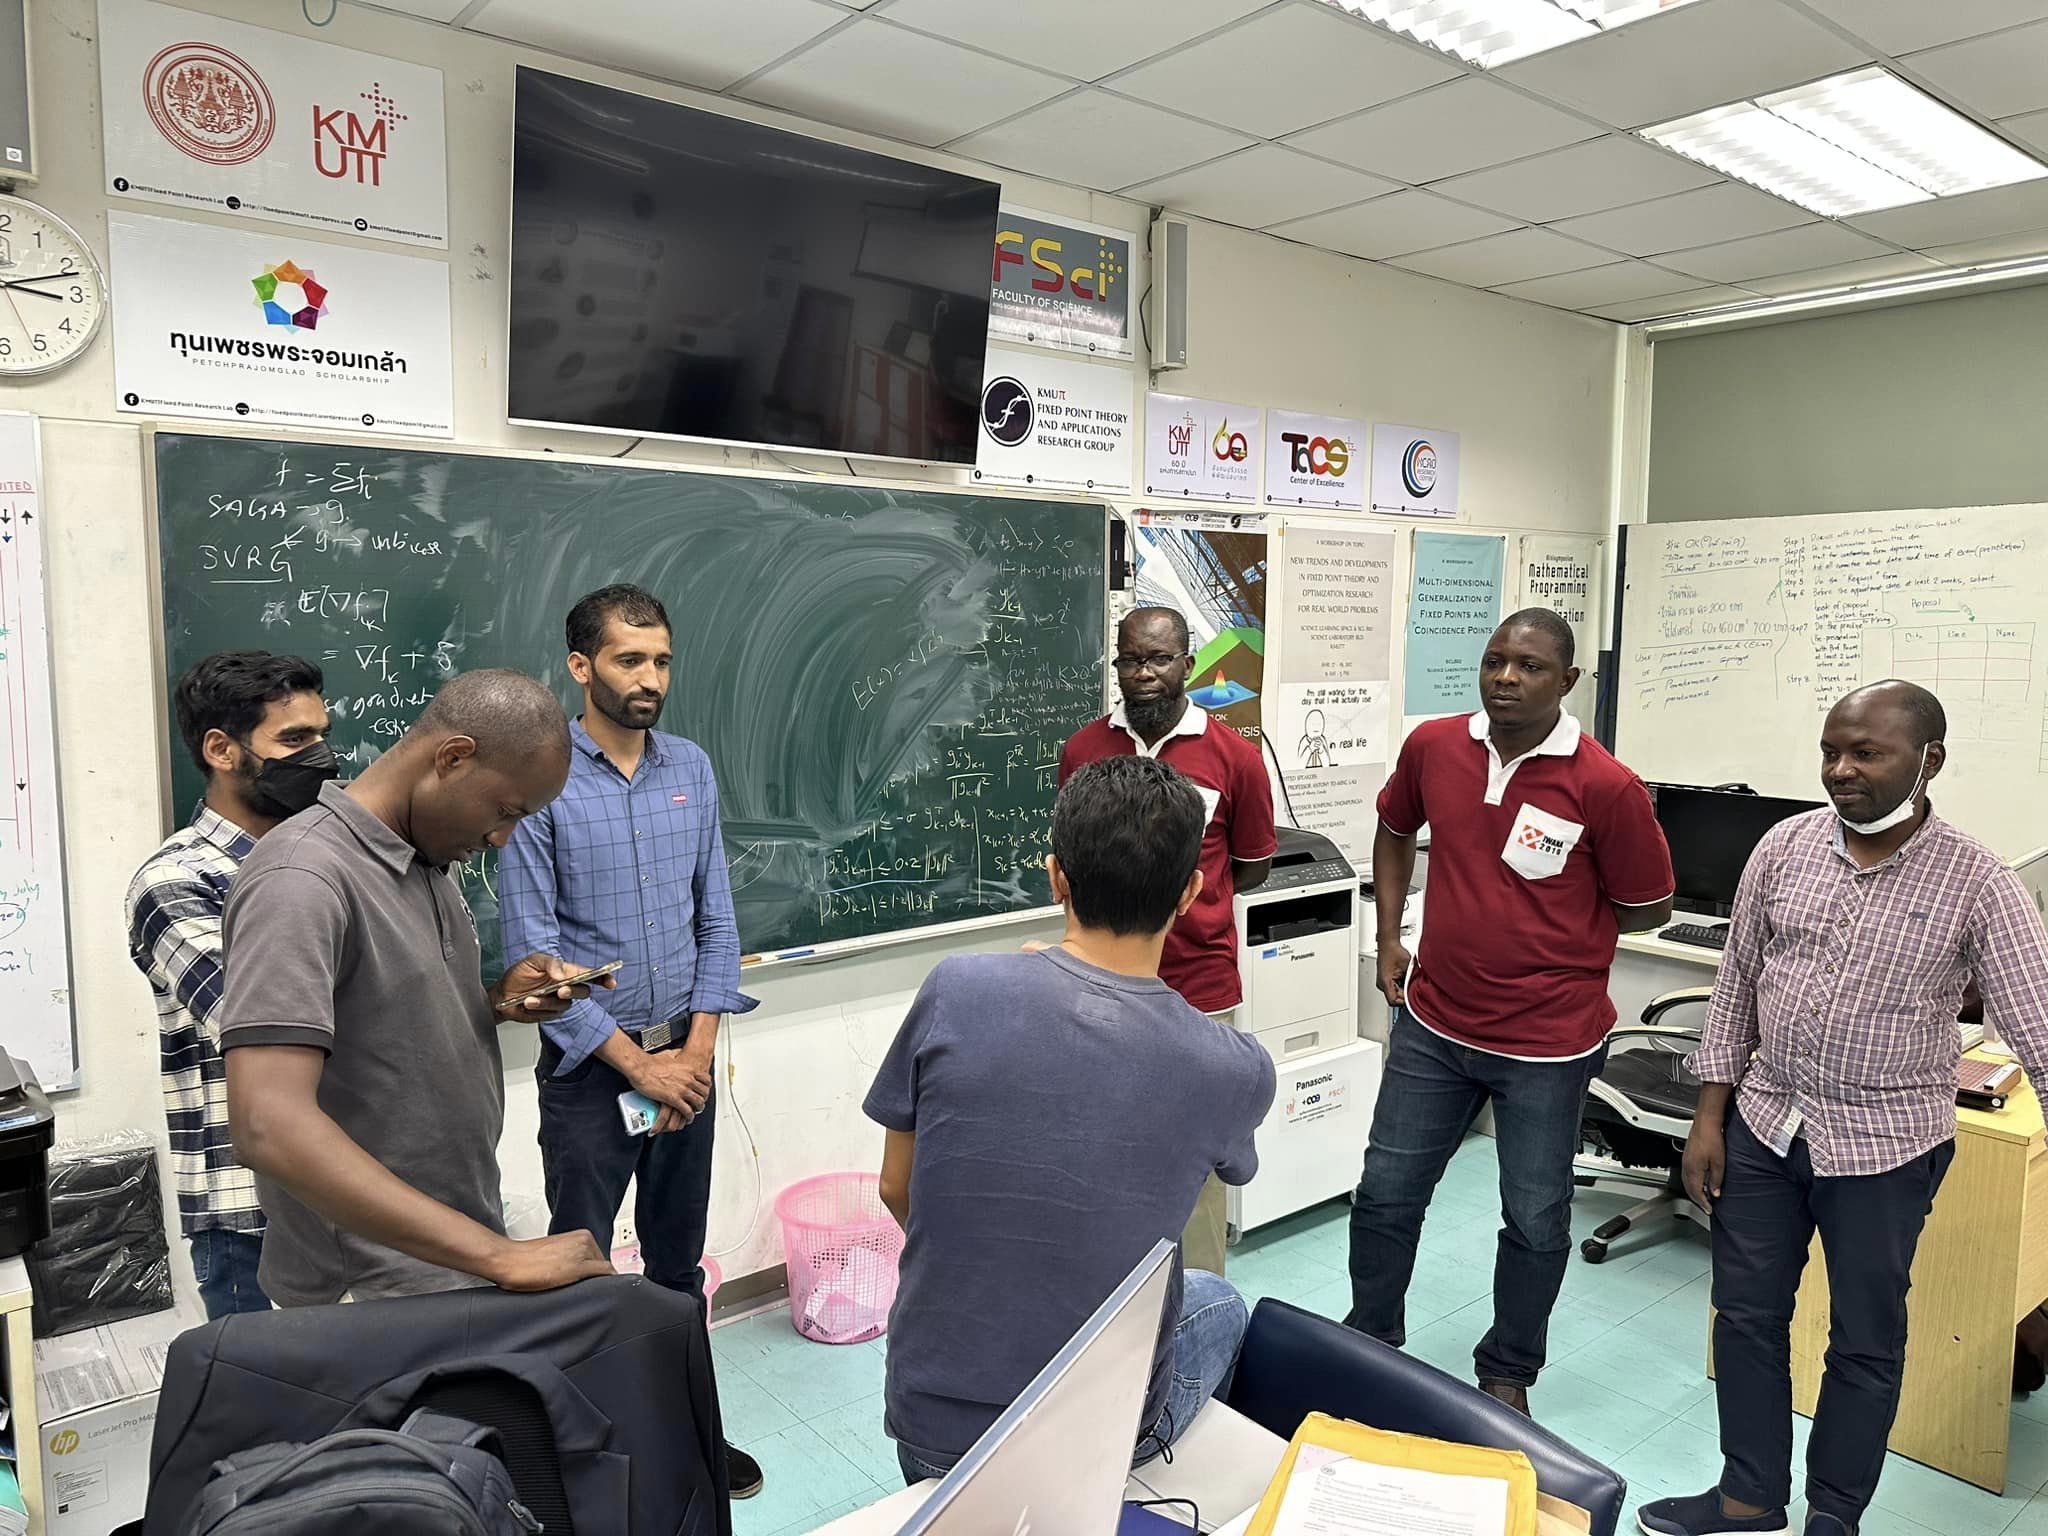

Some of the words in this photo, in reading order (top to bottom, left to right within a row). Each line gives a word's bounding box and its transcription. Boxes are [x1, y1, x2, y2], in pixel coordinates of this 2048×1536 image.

[33, 231, 41, 248] 1
[60, 257, 74, 275] 2
[70, 286, 84, 303] 3
[992, 288, 1036, 304] FACULTY
[1037, 298, 1051, 309] OF
[1053, 300, 1092, 317] SCIENCE
[59, 318, 72, 334] 4
[33, 334, 47, 351] 5
[170, 331, 407, 374] ทุนเพชรพระจอมเกล้า
[315, 371, 391, 384] SCHOLARSHIP
[1037, 403, 1063, 415] FIXED
[1065, 407, 1092, 419] POINT
[1095, 410, 1128, 424] THEORY
[1038, 419, 1058, 430] AND
[1061, 422, 1121, 438] APPLICATIONS
[1038, 435, 1081, 449] RESEARCH
[1084, 440, 1115, 452] GROUP
[1290, 476, 1308, 485] Center
[1316, 479, 1345, 488] Excellence
[208, 494, 287, 520] SAGA
[200, 545, 293, 582] SVRG
[1290, 556, 1304, 565] NEW
[1306, 557, 1329, 566] TRENDS
[1329, 558, 1343, 567] AND
[1344, 559, 1388, 569] DEVELOPMENTS
[1299, 573, 1305, 581] IN
[1307, 573, 1323, 581] FIXED
[1325, 574, 1342, 582] POINT
[1344, 574, 1365, 583] THEORY
[1367, 575, 1380, 584] AND
[1529, 563, 1589, 579] Mathematical
[1419, 577, 1494, 588] MULTI-DIMENSIONAL
[1530, 579, 1587, 598] Programming
[1302, 589, 1344, 598] OPTIMIZATION
[1345, 590, 1373, 598] RESEARCH
[1418, 593, 1482, 603] GENERALIZATION
[1484, 595, 1493, 603] OF
[1298, 604, 1311, 613] FOR
[1311, 605, 1325, 613] REAL
[1328, 605, 1349, 613] WORLD
[1350, 605, 1379, 614] PROBLEMS
[1553, 598, 1563, 607] and
[1420, 609, 1443, 618] FIXED
[1444, 610, 1472, 618] POINTS
[1473, 611, 1488, 619] AND
[1414, 626, 1465, 635] COINCIDENCE
[1467, 626, 1493, 634] POINTS
[1347, 688, 1356, 696] for
[1232, 726, 1261, 738] YSIS
[1339, 738, 1353, 749] real
[1356, 737, 1367, 748] life
[1296, 1073, 1333, 1091] Panasonic
[88, 1422, 122, 1439] LaserJet
[123, 1419, 138, 1428] Pro
